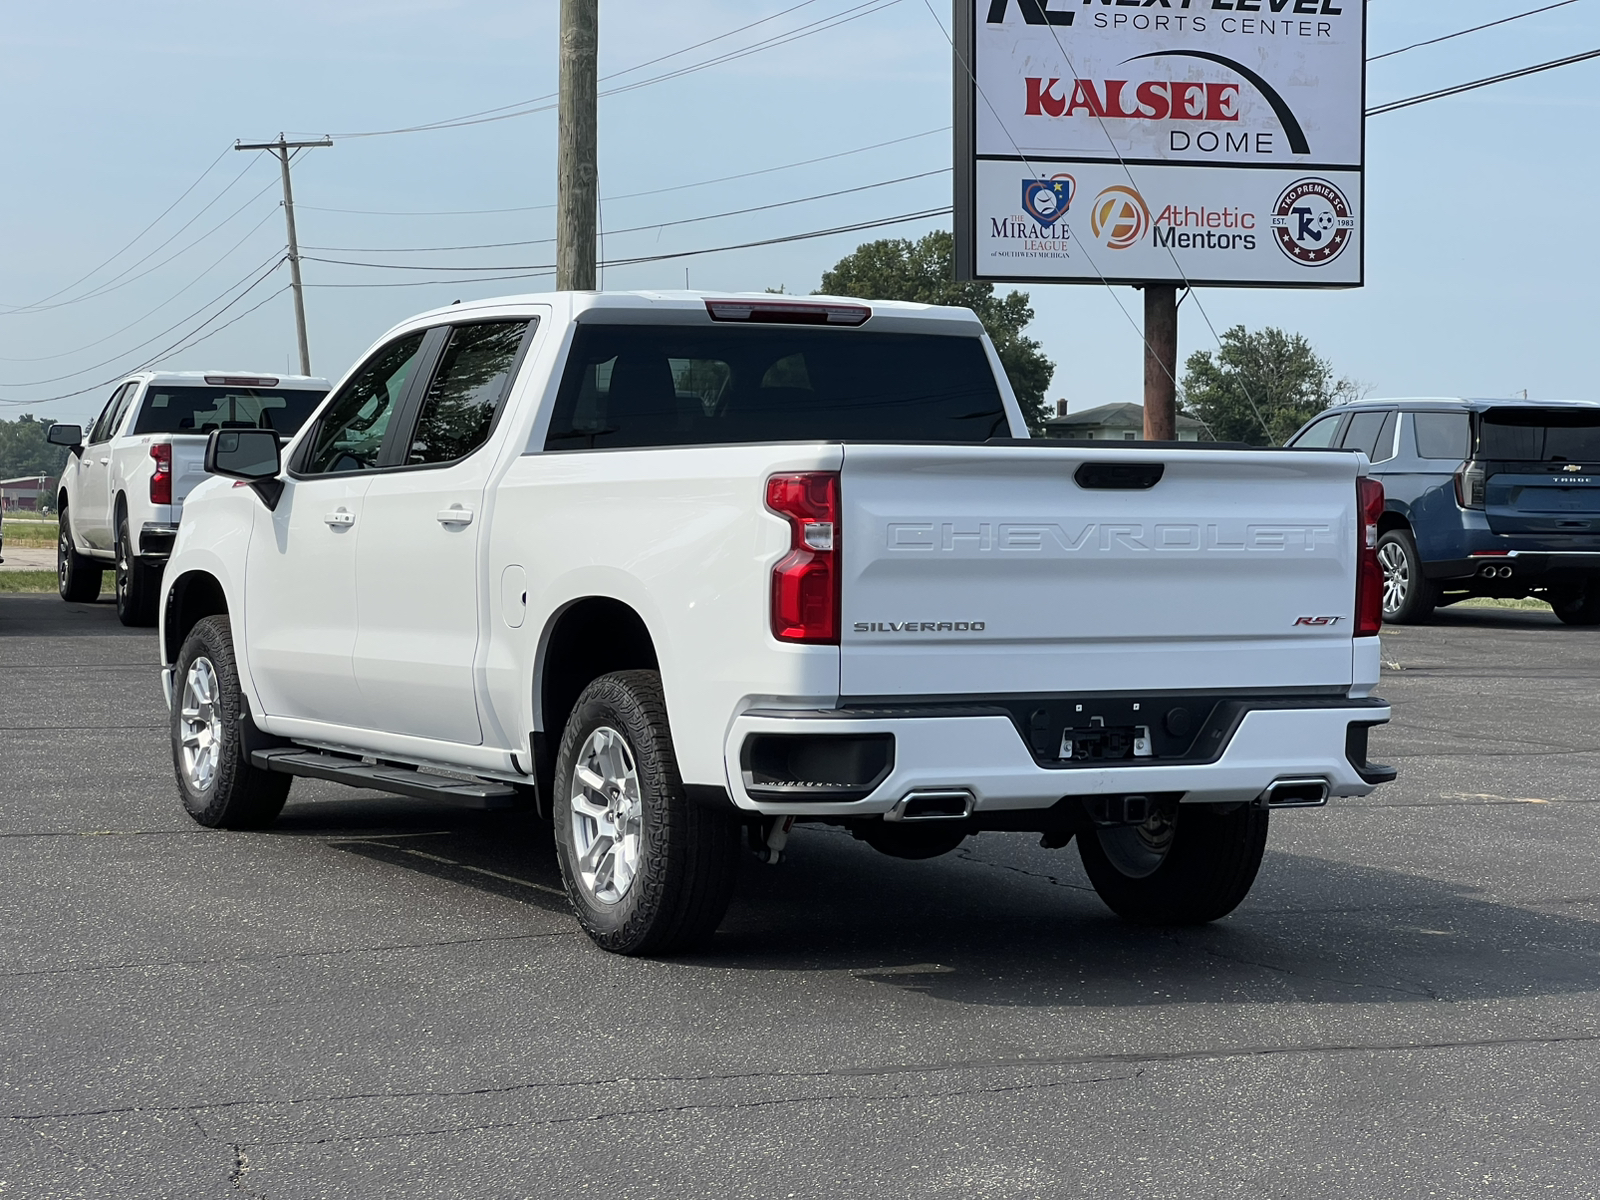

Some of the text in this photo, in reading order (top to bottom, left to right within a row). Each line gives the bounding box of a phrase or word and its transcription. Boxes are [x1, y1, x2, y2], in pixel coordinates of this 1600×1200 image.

[1094, 12, 1207, 32] SPORTS
[1221, 17, 1331, 38] CENTER
[1024, 77, 1239, 121] KALSEE
[1170, 131, 1273, 153] DOME
[1281, 184, 1344, 211] TKO PREMIER SC
[1154, 204, 1256, 229] Athletic
[1272, 217, 1287, 225] EST.
[1337, 219, 1354, 227] 1983
[990, 217, 1070, 240] MIRACLE
[1153, 226, 1256, 250] Mentors
[1024, 240, 1067, 251] LEAGUE
[887, 523, 1330, 551] CHEVROLET
[853, 621, 985, 632] SILVERADO
[1291, 616, 1346, 626] RST
